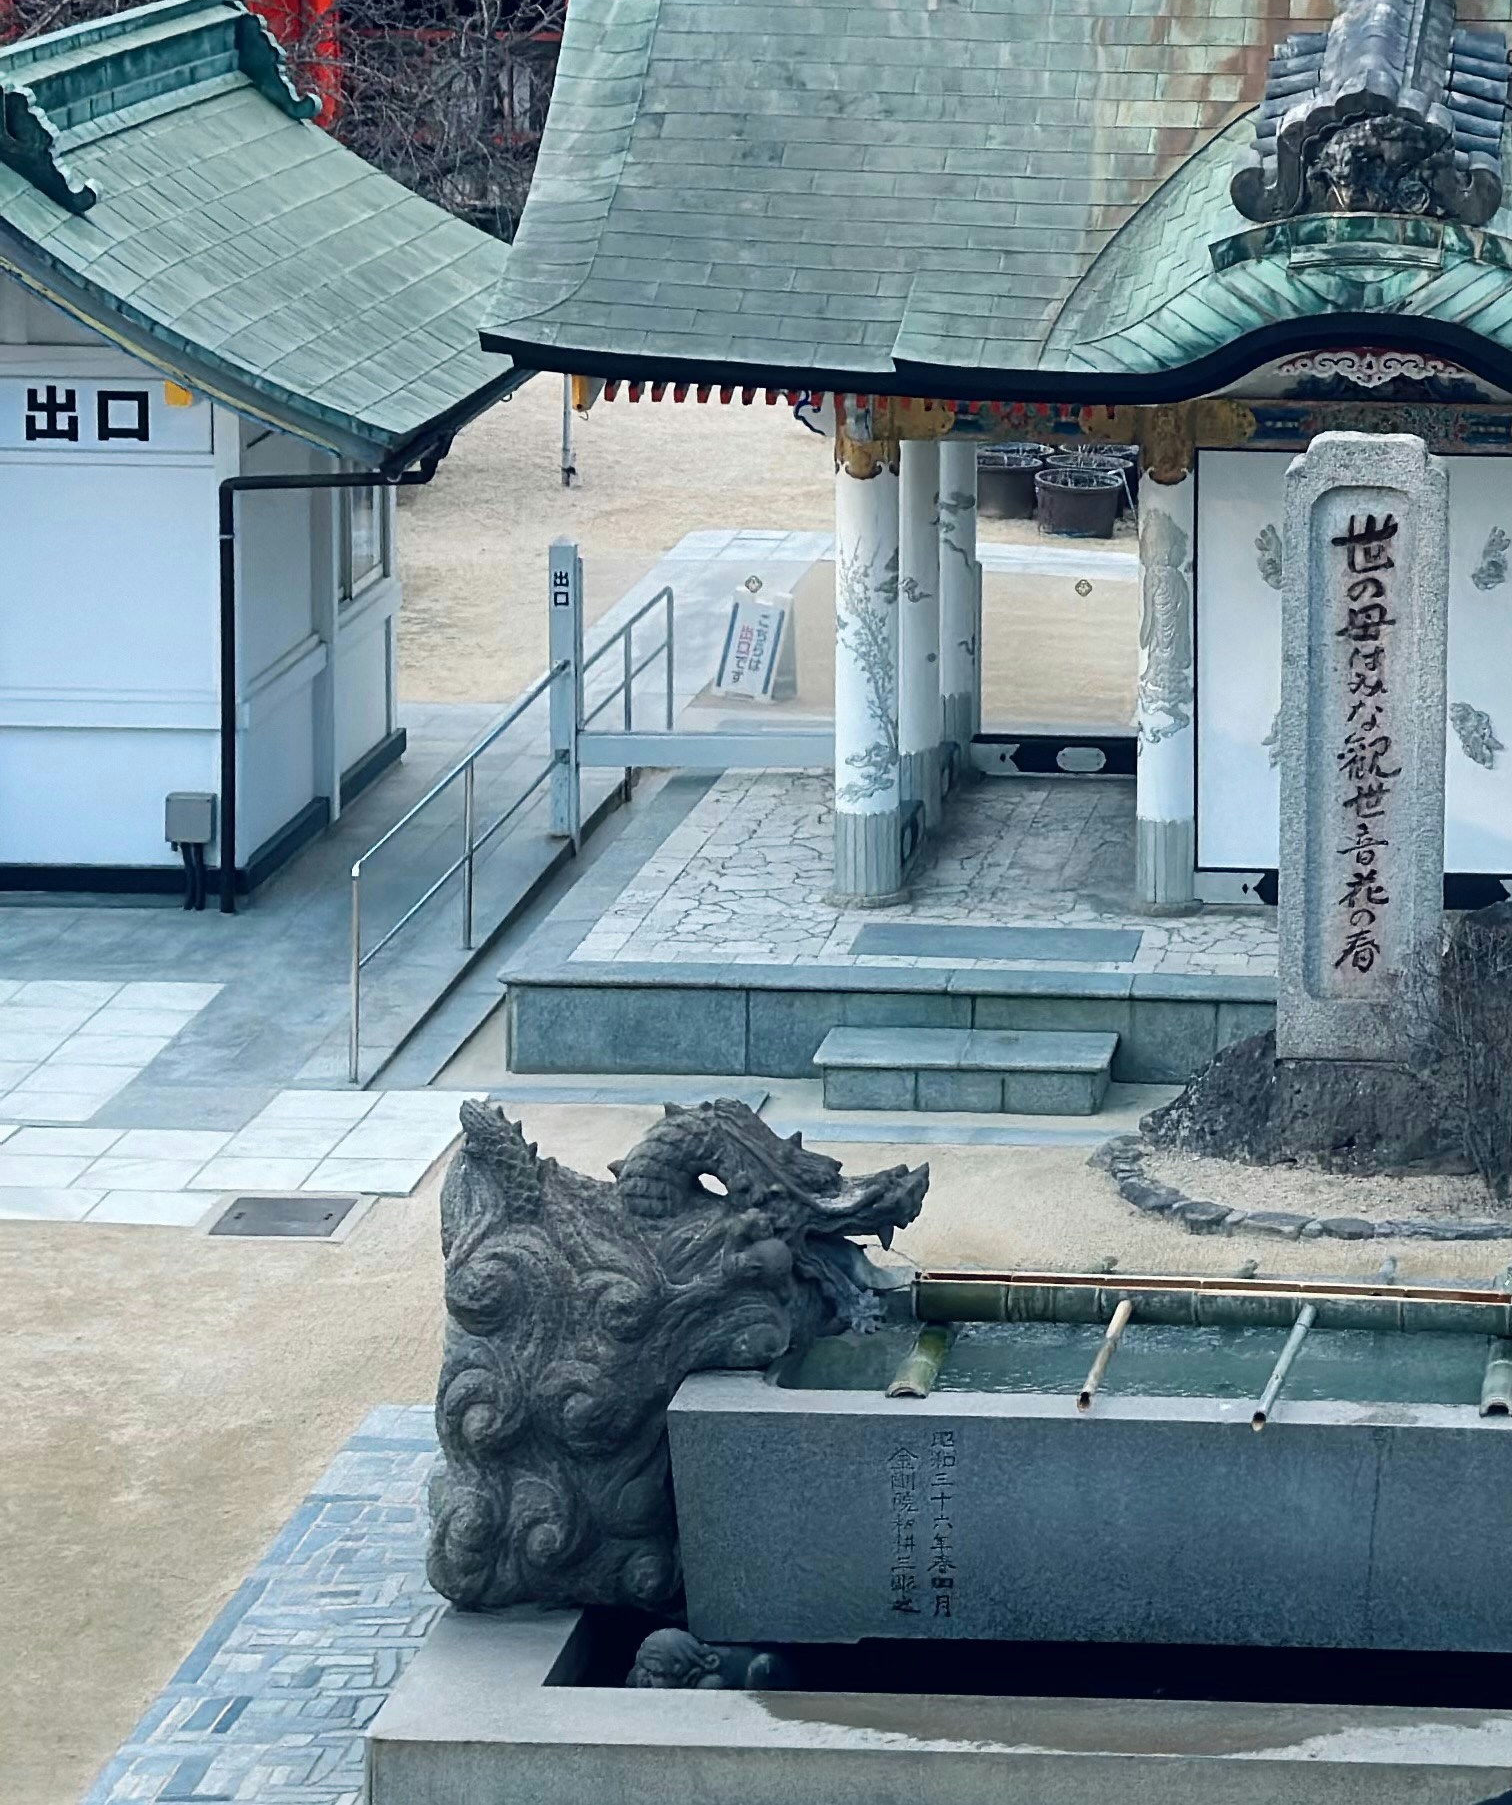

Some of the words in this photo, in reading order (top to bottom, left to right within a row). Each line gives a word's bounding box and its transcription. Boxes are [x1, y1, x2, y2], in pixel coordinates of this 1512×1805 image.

[25, 385, 149, 442] 出口
[553, 571, 569, 607] 出口
[731, 625, 753, 683] 出口です
[748, 613, 770, 671] こちらは
[1331, 512, 1403, 974] 世の母はみな観世音花の春
